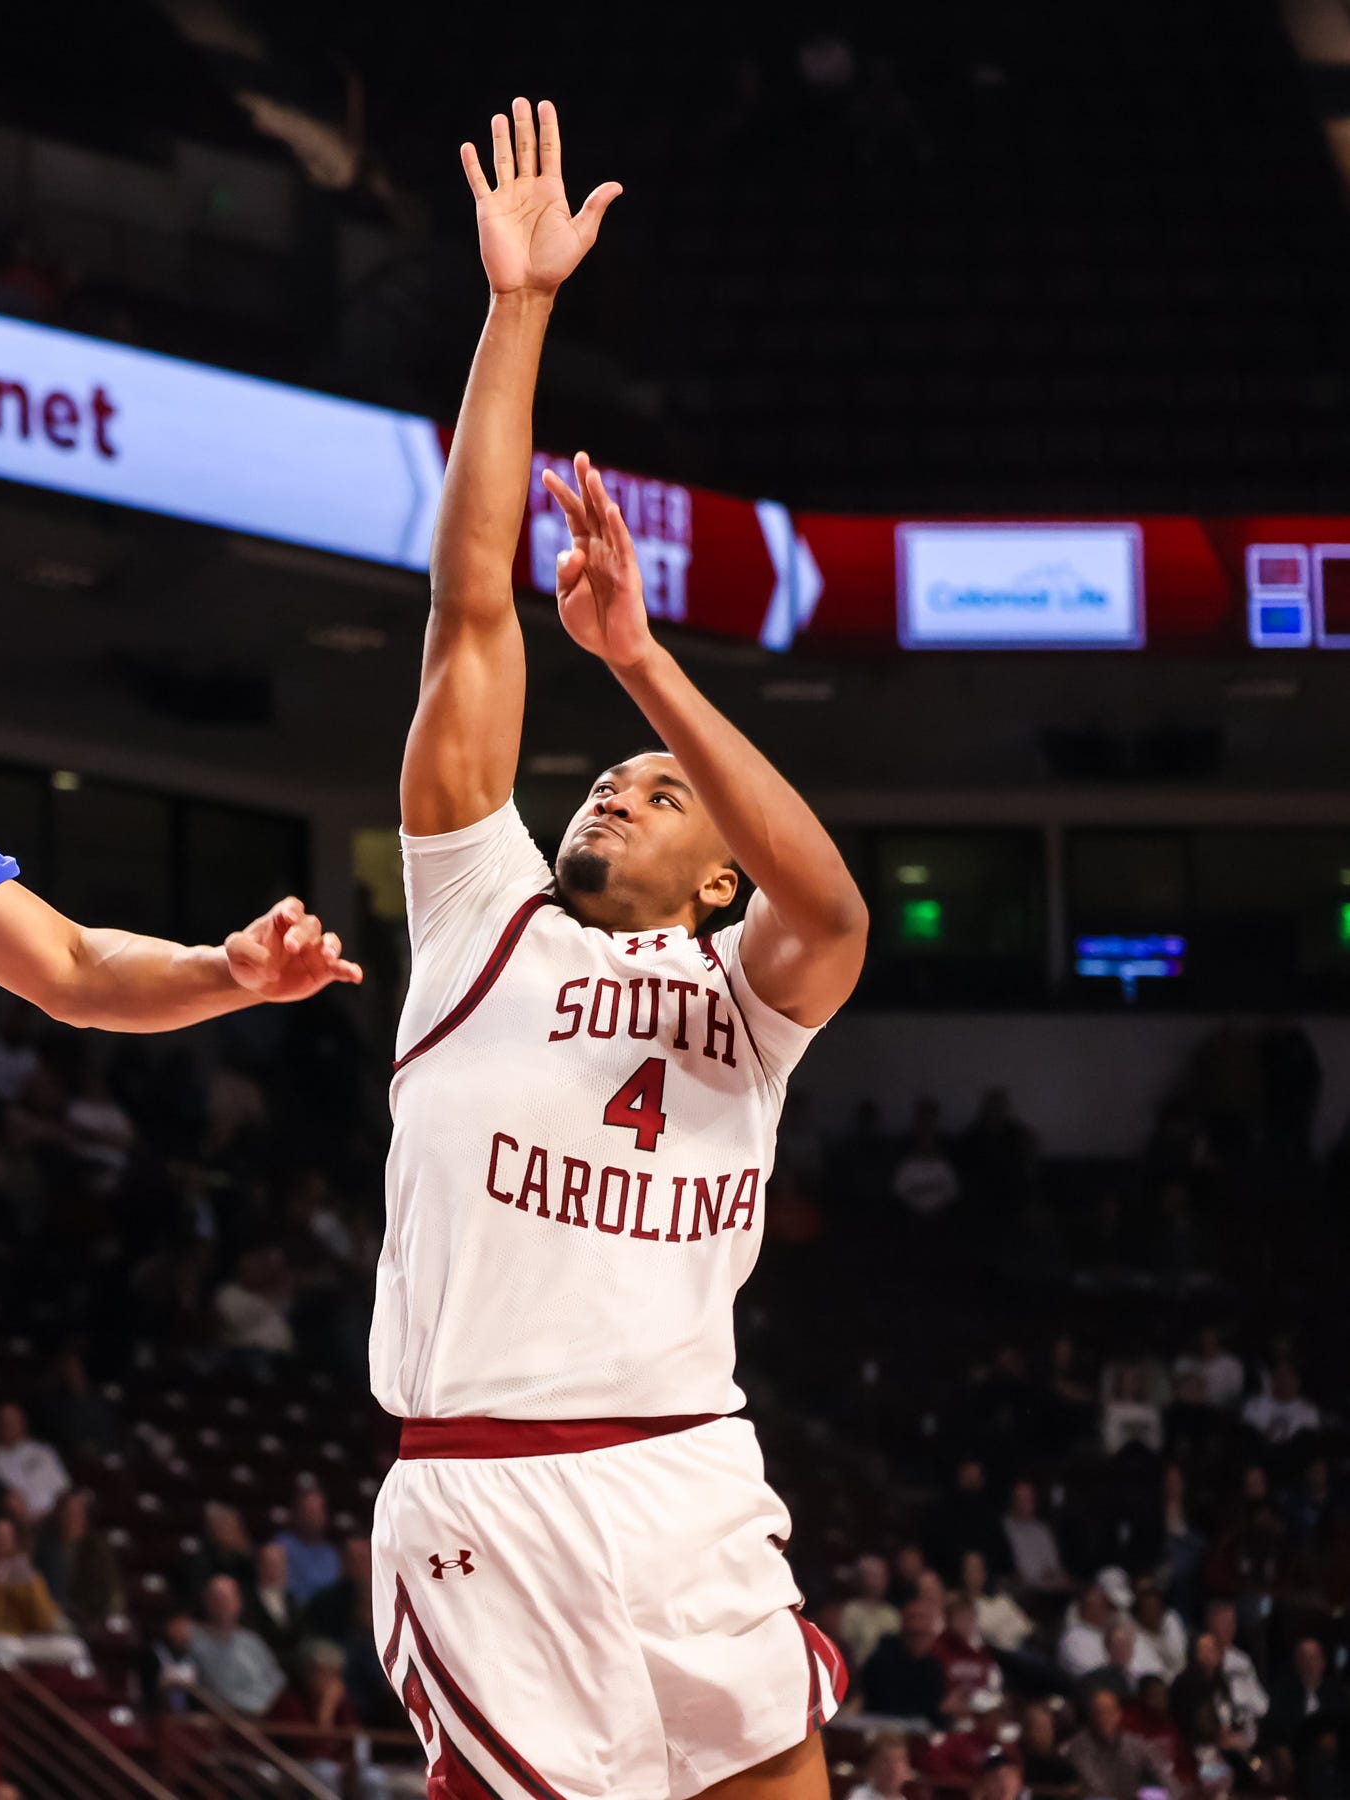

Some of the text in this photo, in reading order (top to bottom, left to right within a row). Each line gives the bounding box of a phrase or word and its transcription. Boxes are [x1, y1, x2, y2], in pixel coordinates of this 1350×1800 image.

[548, 977, 737, 1068] SOUTH
[602, 1056, 667, 1152] 4
[486, 1131, 760, 1243] CAROLINA
